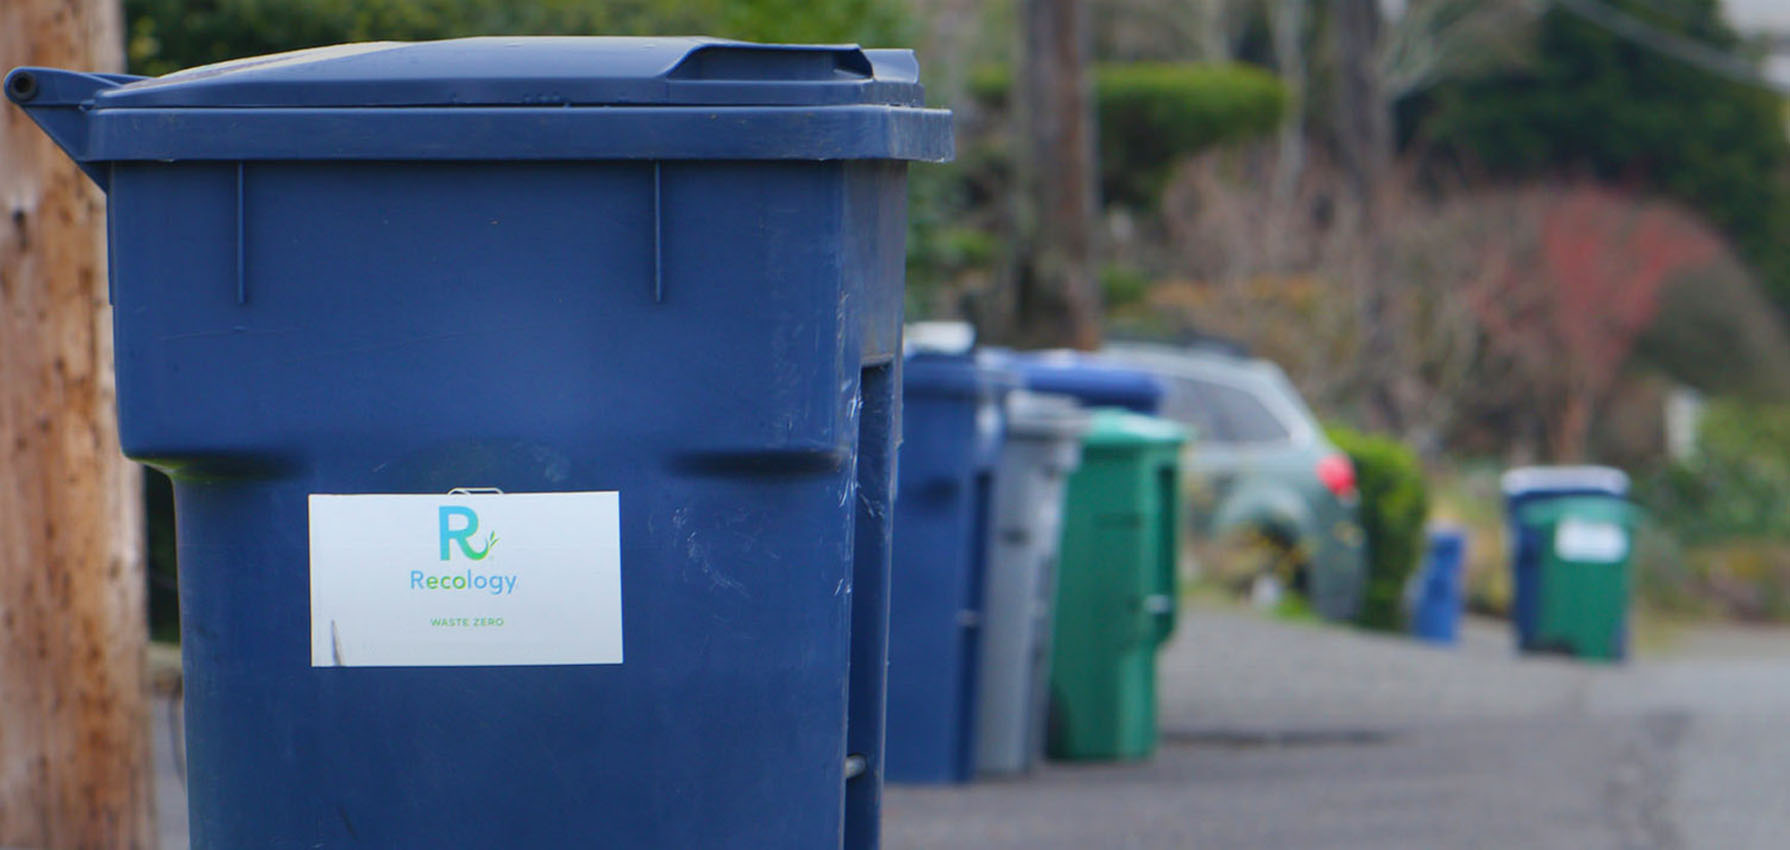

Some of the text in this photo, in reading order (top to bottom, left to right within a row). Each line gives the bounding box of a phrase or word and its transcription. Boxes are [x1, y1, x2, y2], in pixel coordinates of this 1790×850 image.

[438, 505, 491, 561] R
[410, 569, 517, 595] Recology
[430, 617, 505, 627] WASTE ZERO
